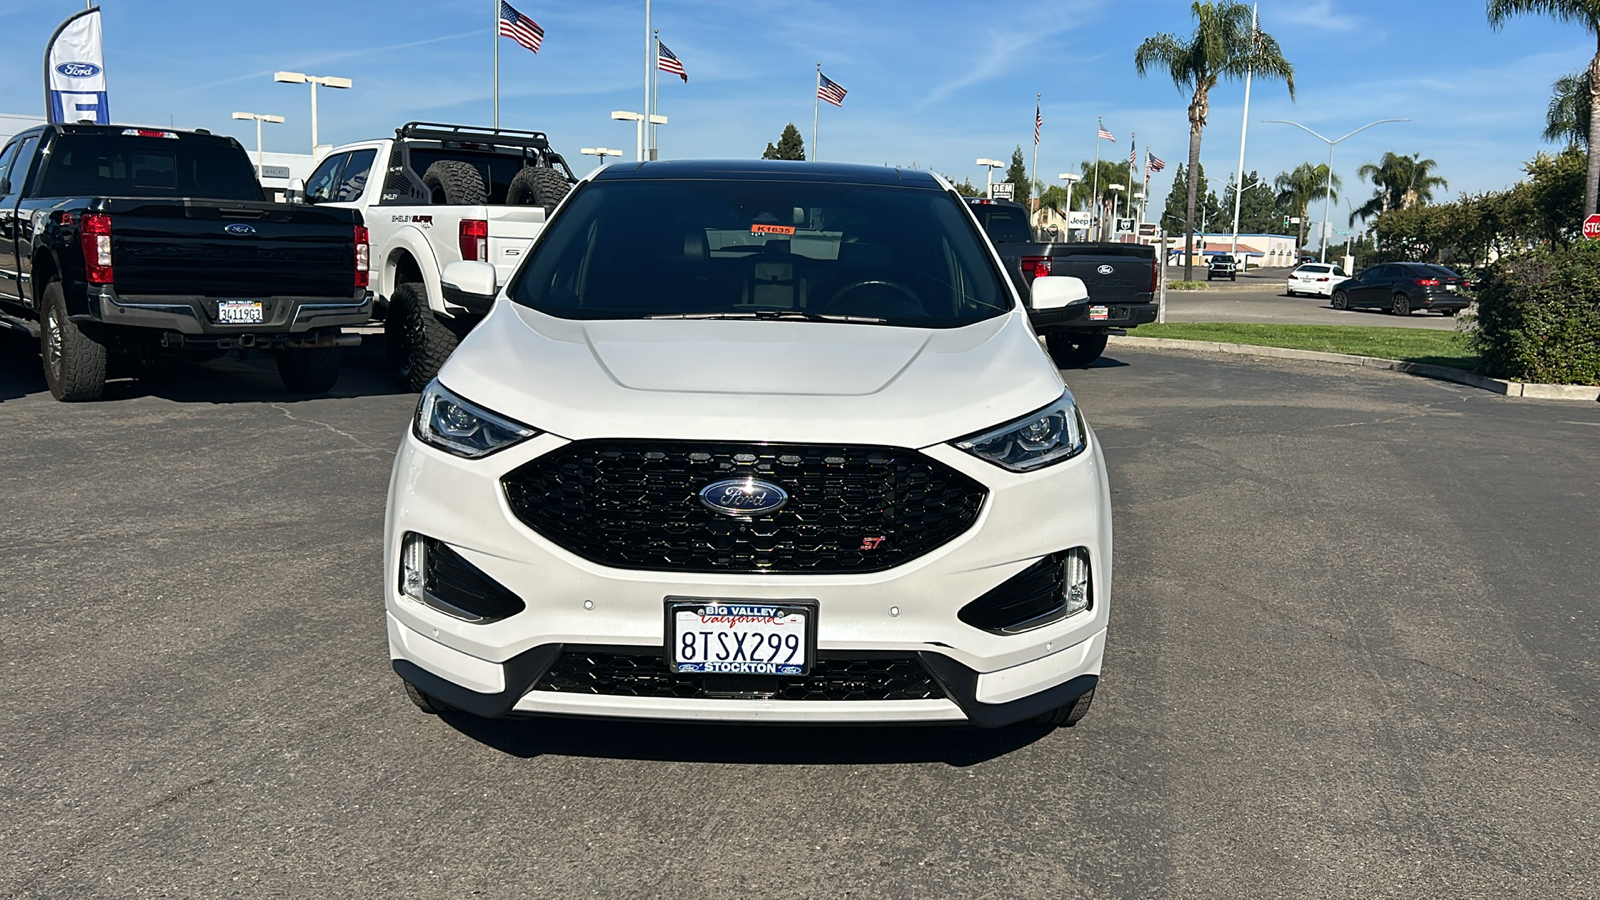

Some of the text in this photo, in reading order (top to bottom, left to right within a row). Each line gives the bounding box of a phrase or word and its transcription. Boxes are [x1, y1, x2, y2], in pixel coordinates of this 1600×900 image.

[65, 63, 93, 76] Ford
[993, 184, 1012, 193] OEM
[391, 214, 411, 223] SHELBY
[1069, 217, 1089, 226] Jeep
[757, 225, 791, 234] K1635
[720, 486, 768, 507] Ford
[705, 606, 777, 617] BIG VALLEY
[701, 614, 785, 629] California
[681, 630, 800, 663] 8TSX299
[703, 661, 776, 674] STOCKTON
